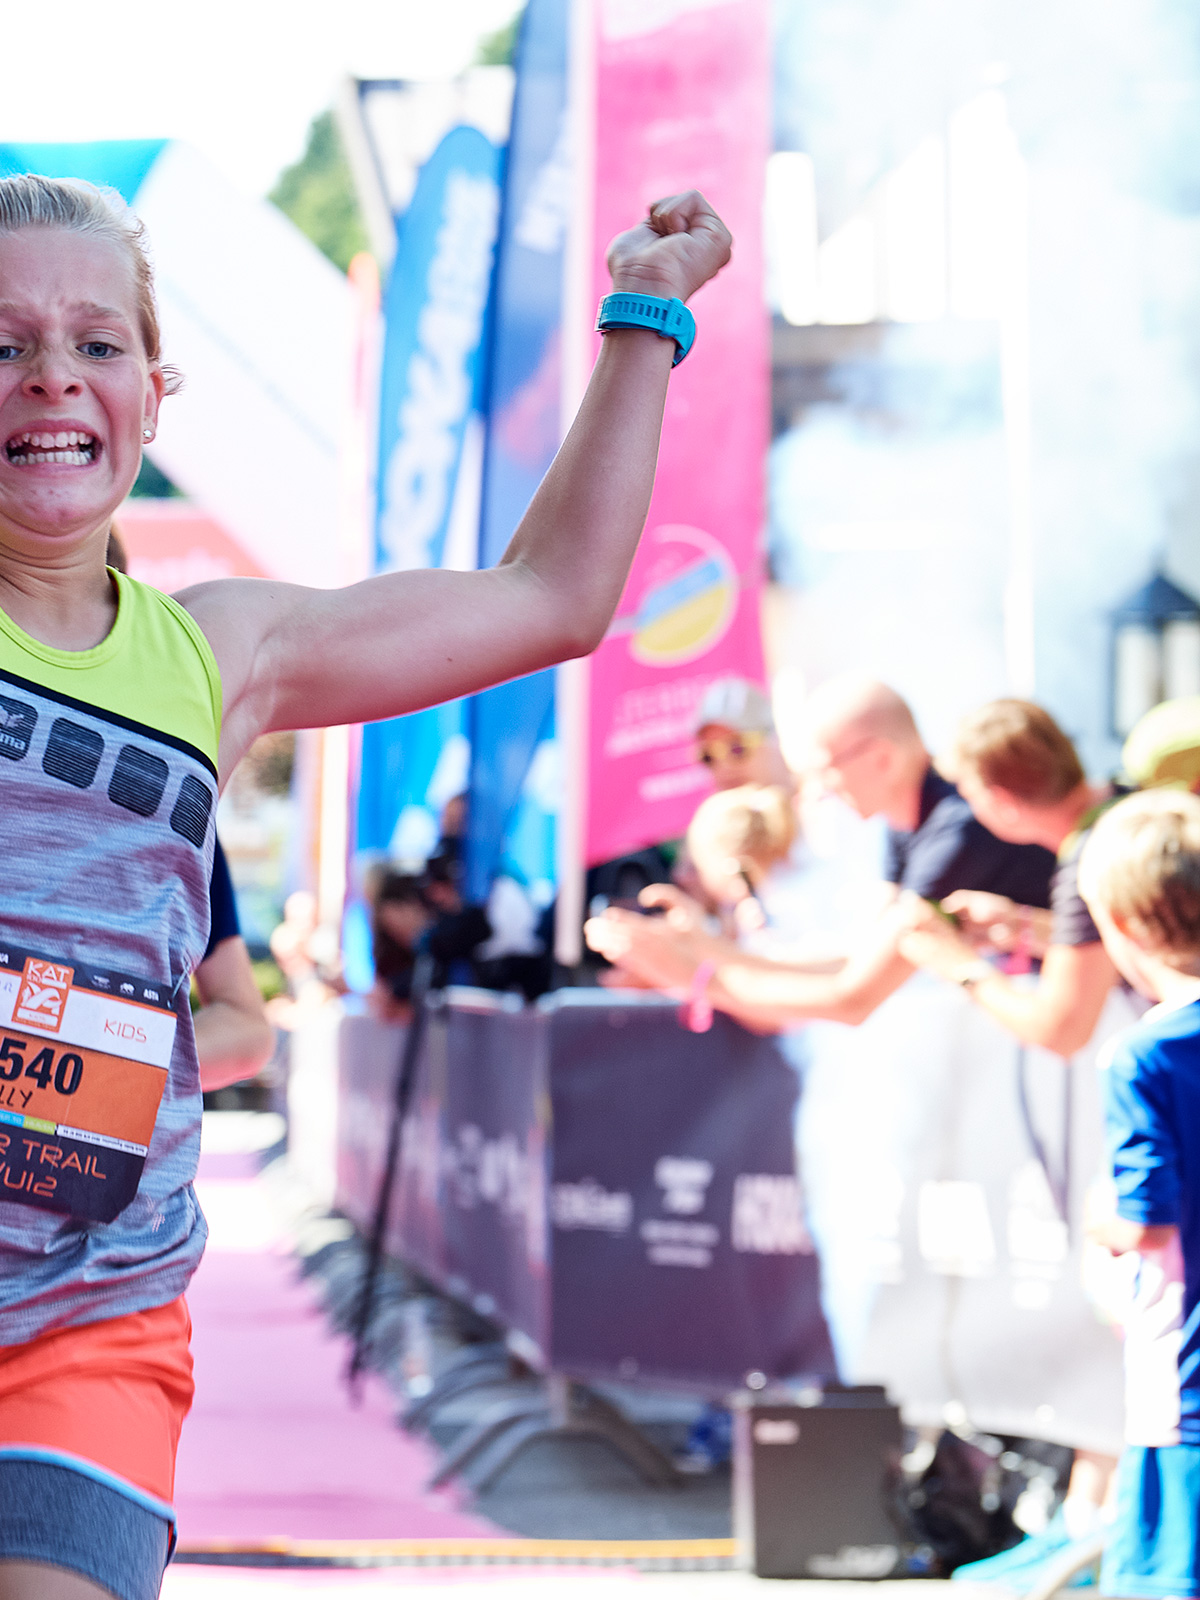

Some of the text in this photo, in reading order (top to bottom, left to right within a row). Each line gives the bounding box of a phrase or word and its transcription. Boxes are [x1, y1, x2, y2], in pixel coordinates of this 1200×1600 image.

[27, 961, 70, 983] KAT
[104, 1018, 147, 1043] KIDS
[22, 1138, 107, 1180] TRAIL
